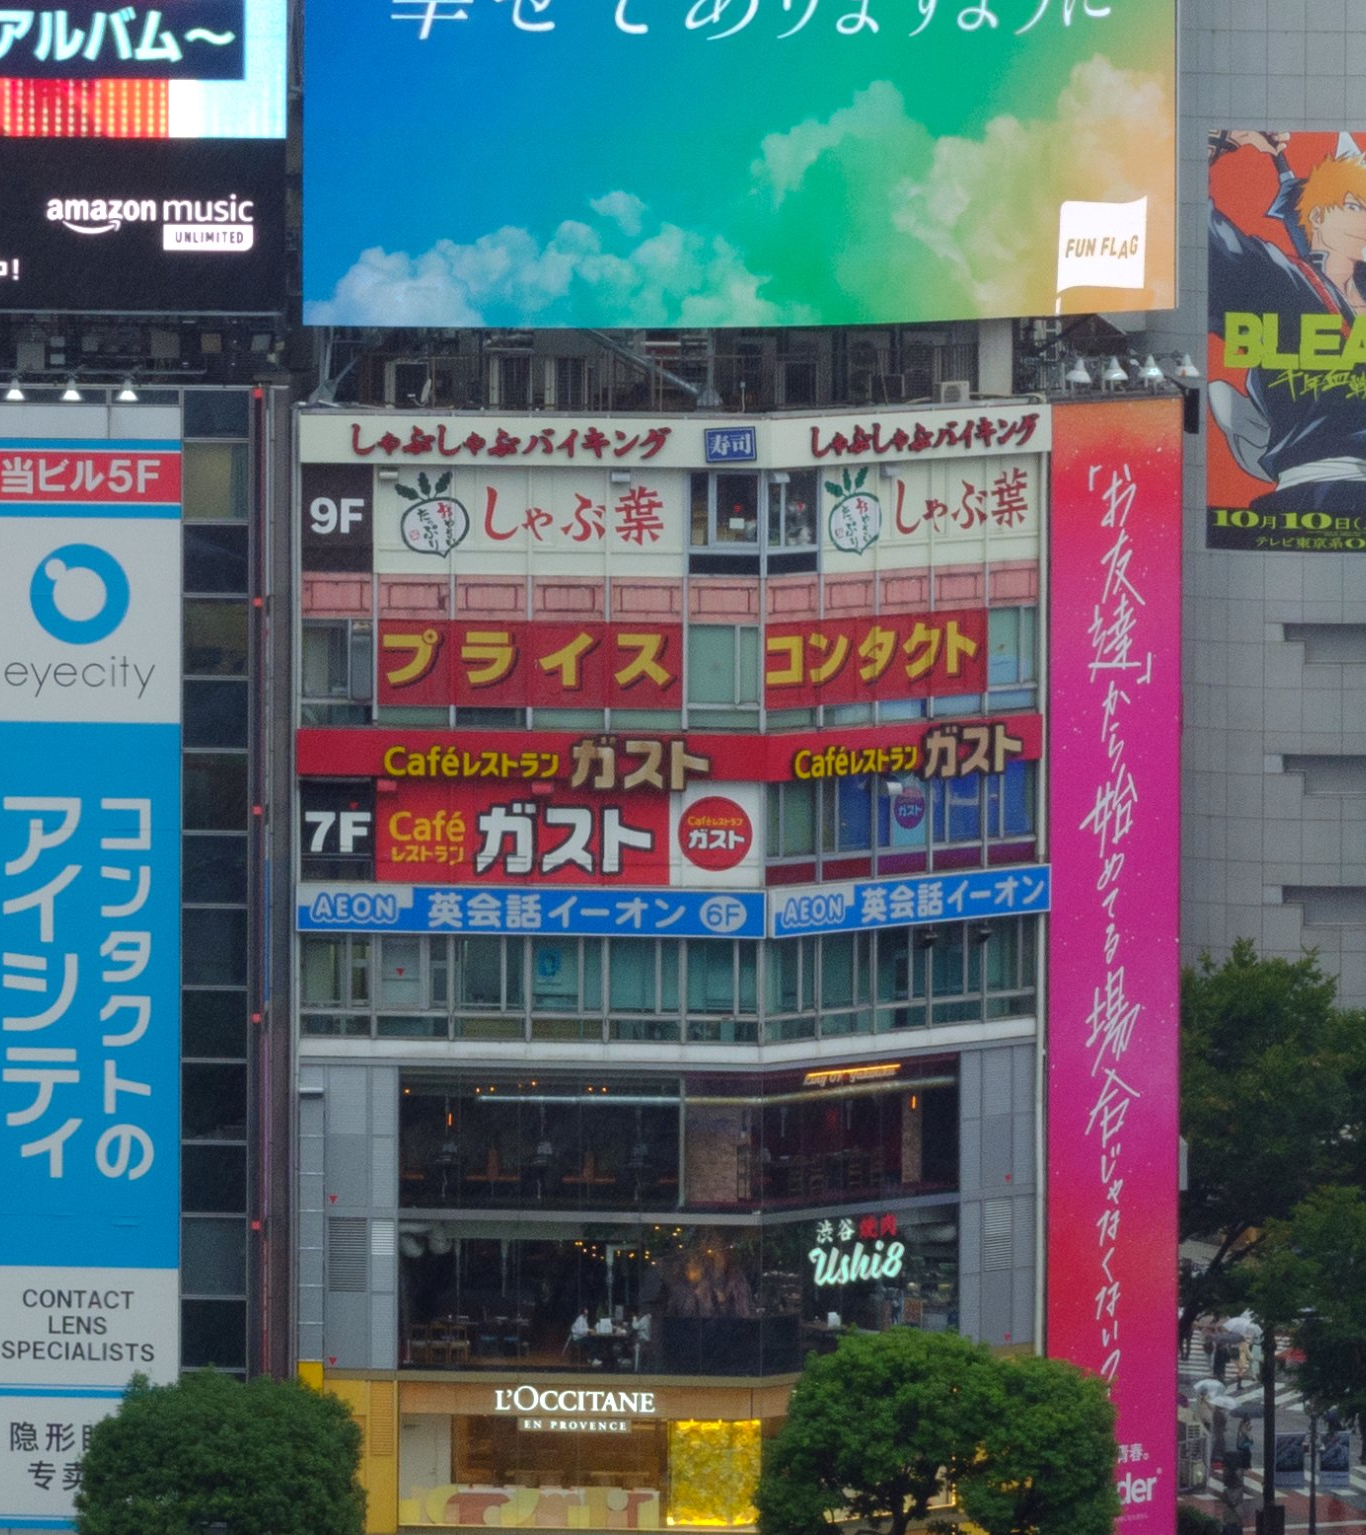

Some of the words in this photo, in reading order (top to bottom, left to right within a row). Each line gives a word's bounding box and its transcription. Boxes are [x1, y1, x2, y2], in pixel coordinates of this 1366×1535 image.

[46, 197, 158, 223] amazon
[163, 194, 254, 223] music
[175, 230, 245, 245] UNLIMITED
[1064, 235, 1098, 261] FUN
[1100, 232, 1140, 262] FLAG
[350, 423, 672, 459] しゃぶしゃぶバイキング
[709, 432, 753, 456] 寿司
[810, 413, 1041, 458] しゃぶしゃぶバイキング
[1, 457, 161, 494] 当ビル5F
[309, 497, 365, 535] 9F
[483, 485, 665, 545] しゃぶ葉
[894, 467, 1029, 535] しゃぶ葉
[382, 629, 675, 690] プライス
[766, 620, 978, 685] コンタクト
[4, 655, 156, 700] eyecity
[570, 737, 710, 791] ガスト
[924, 724, 1023, 777] ガスト
[305, 811, 371, 853] 7F
[388, 810, 466, 842] Café
[474, 800, 653, 875] ガスト
[688, 828, 745, 851] ガスト
[391, 844, 465, 866] レストラン
[313, 893, 397, 921] AEON
[427, 892, 686, 929] 英会話イーオン
[705, 903, 741, 927] 6F
[784, 895, 845, 925] AEON
[860, 875, 1045, 923] 英会話イーオン
[2, 796, 84, 1179] アイシティ
[95, 797, 155, 1181] コンタクトの
[816, 1218, 856, 1244] 渋谷
[808, 1239, 906, 1287] Ushi8
[22, 1288, 135, 1310] CONTACT
[47, 1315, 108, 1336] LENS
[0, 1340, 155, 1362] SPECIALISTS
[494, 1385, 656, 1415] L'OCCITANE
[523, 1418, 545, 1431] EN
[549, 1418, 629, 1432] PROVENCE
